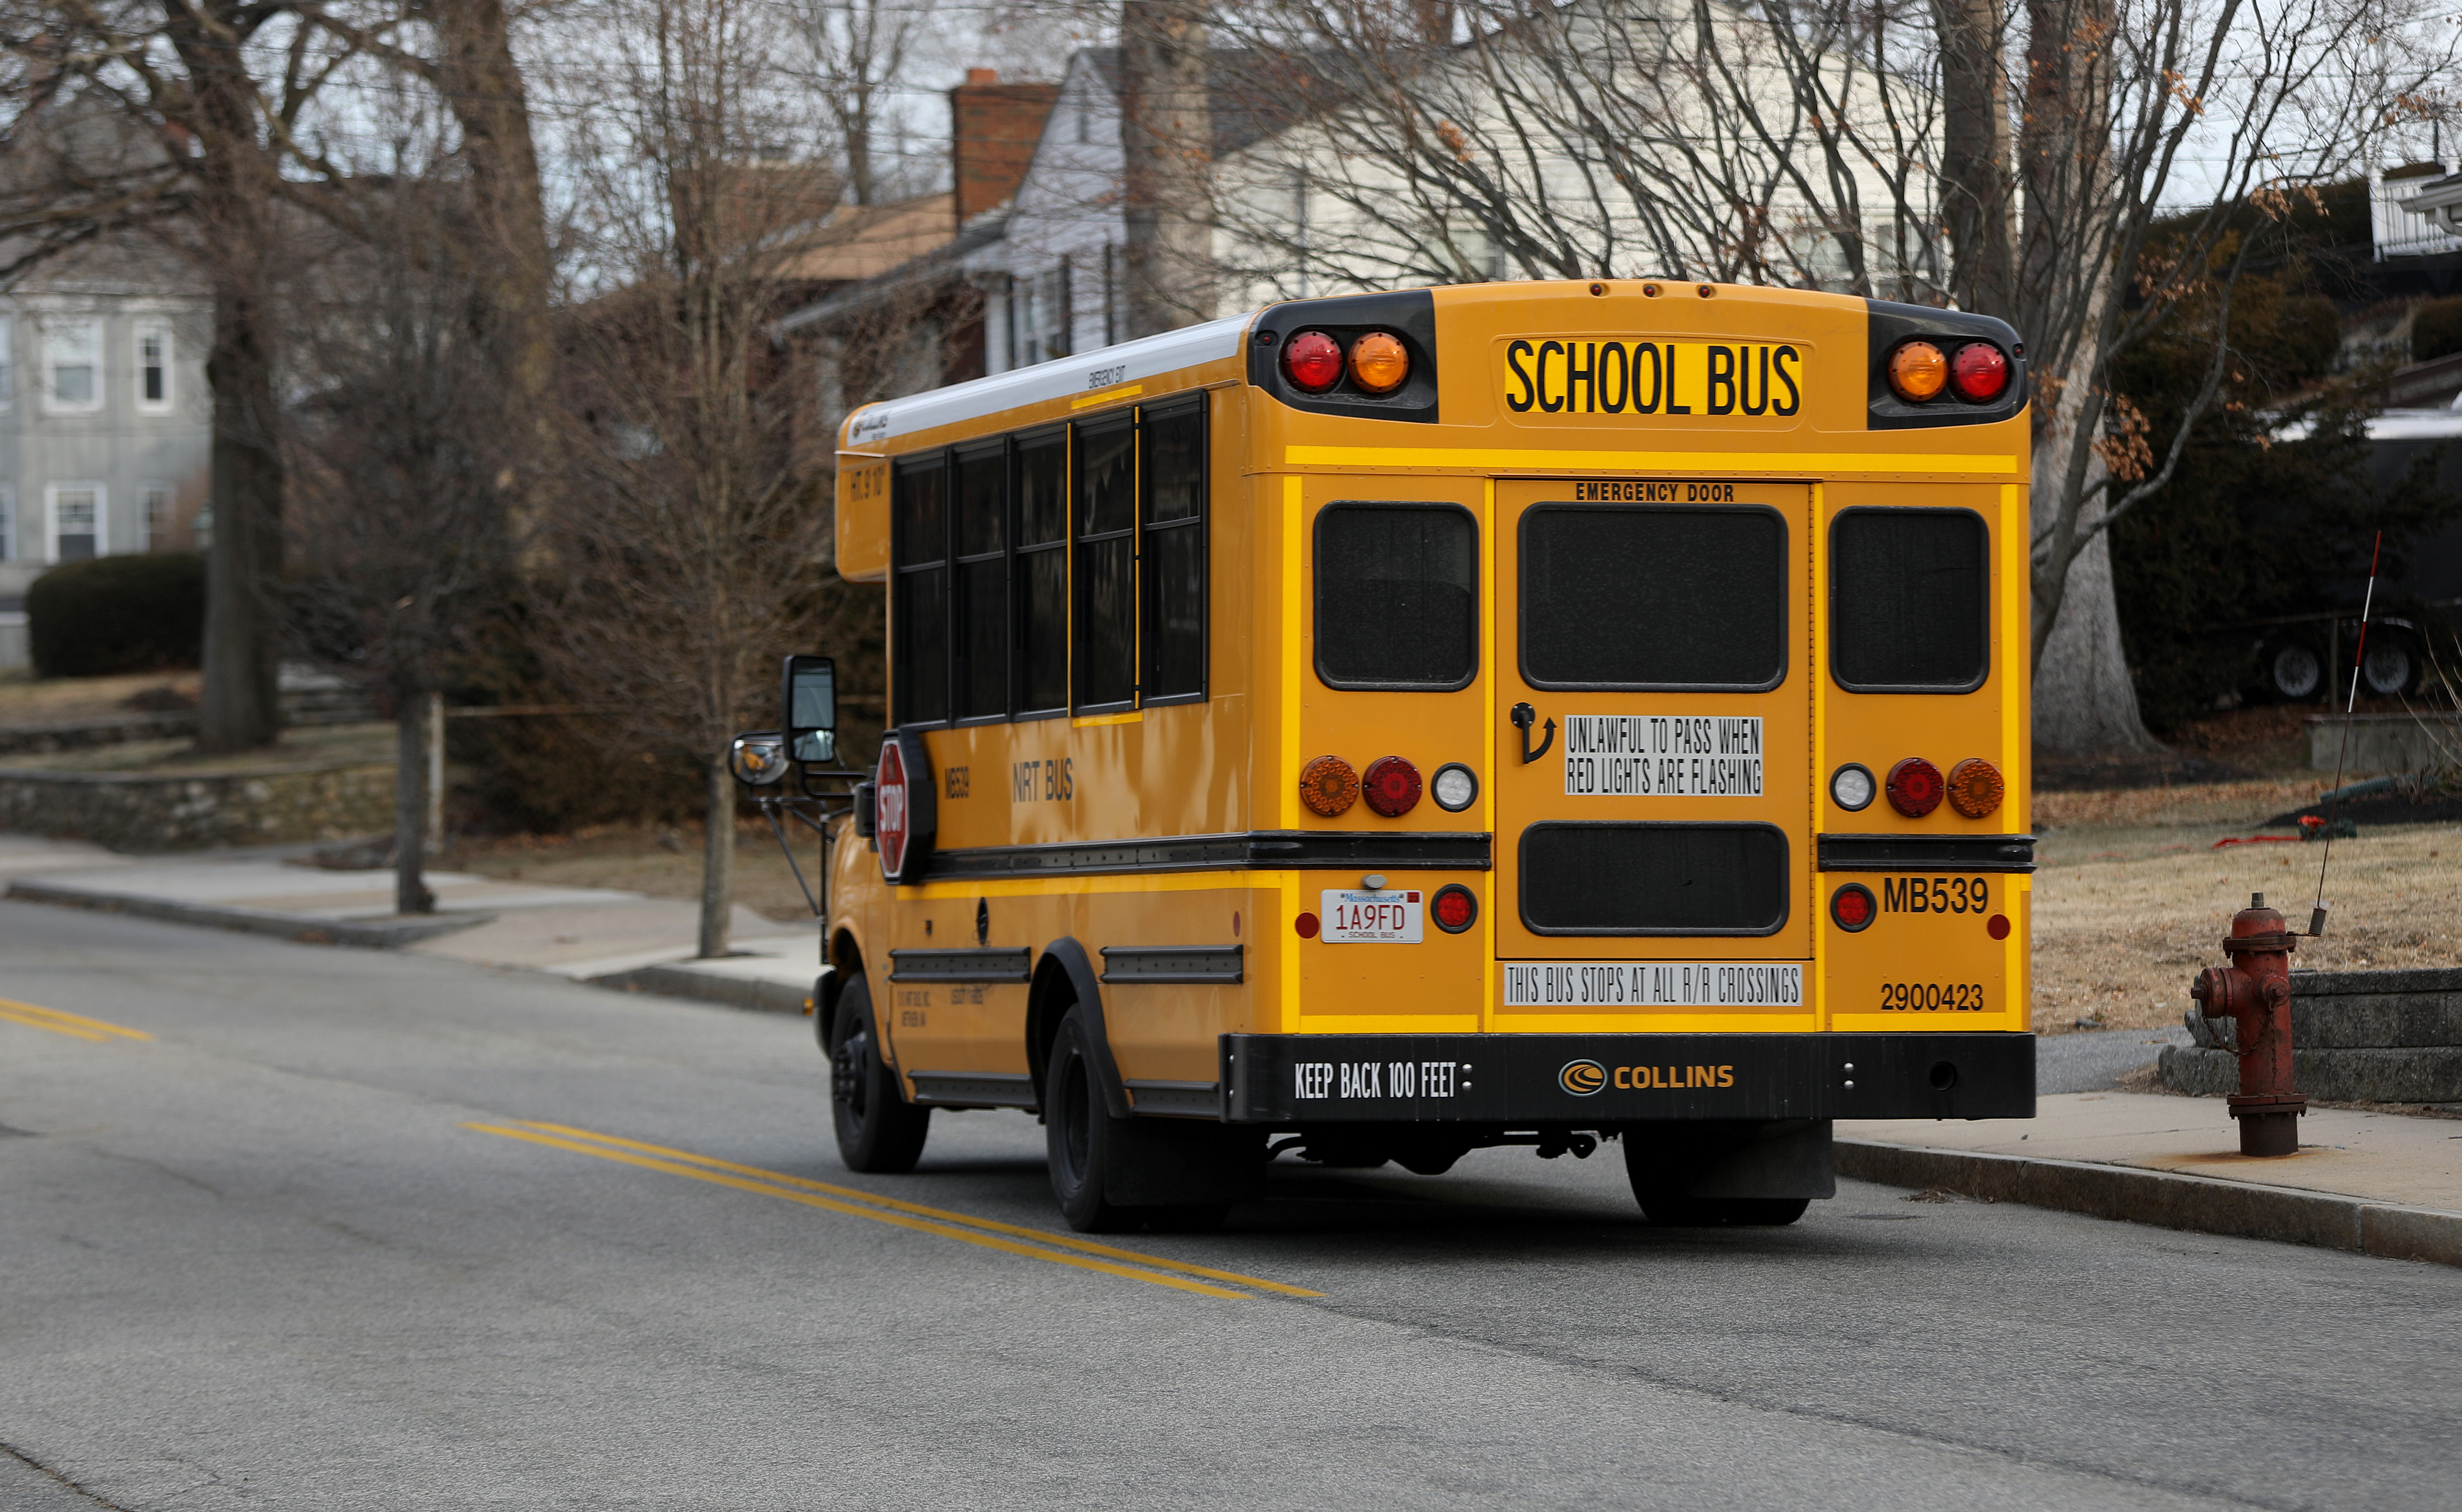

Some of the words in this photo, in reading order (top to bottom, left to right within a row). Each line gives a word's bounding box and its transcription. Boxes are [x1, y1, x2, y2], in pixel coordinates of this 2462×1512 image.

[1507, 340, 1691, 415] SCHOOL
[1707, 345, 1799, 416] BUS
[1576, 482, 1677, 502] EMERGENCY
[1688, 483, 1734, 502] DOOR
[1568, 717, 1645, 754] UNLAWFUL
[1650, 717, 1668, 754] TO
[1675, 718, 1712, 754] PASS
[1719, 718, 1759, 755] WHEN
[945, 766, 969, 799] MB539
[1013, 760, 1040, 803] NRT
[1045, 757, 1073, 801] BUS
[1567, 757, 1594, 793] RED
[1602, 757, 1650, 794] LIGHTS
[1658, 758, 1684, 794] ARE
[1692, 758, 1761, 795] FLASHING
[879, 784, 904, 832] STOP
[1344, 893, 1401, 903] Massachusetts
[1883, 877, 1989, 914] MB539
[1335, 904, 1405, 930] 1A9FD
[1507, 967, 1539, 1003] THIS
[1546, 967, 1574, 1003] BUS
[1581, 967, 1624, 1003] STOPS
[1631, 967, 1646, 1003] AT
[1653, 967, 1676, 1003] ALL
[1683, 965, 1711, 1005] R/R
[1718, 967, 1799, 1004] CROSSINGS
[1881, 983, 1984, 1011] 2900423
[1294, 1063, 1334, 1099] KEEP
[1340, 1062, 1381, 1099] BACK
[1388, 1062, 1415, 1098] 100
[1422, 1062, 1457, 1098] FEET
[1614, 1065, 1734, 1089] COLLINS
